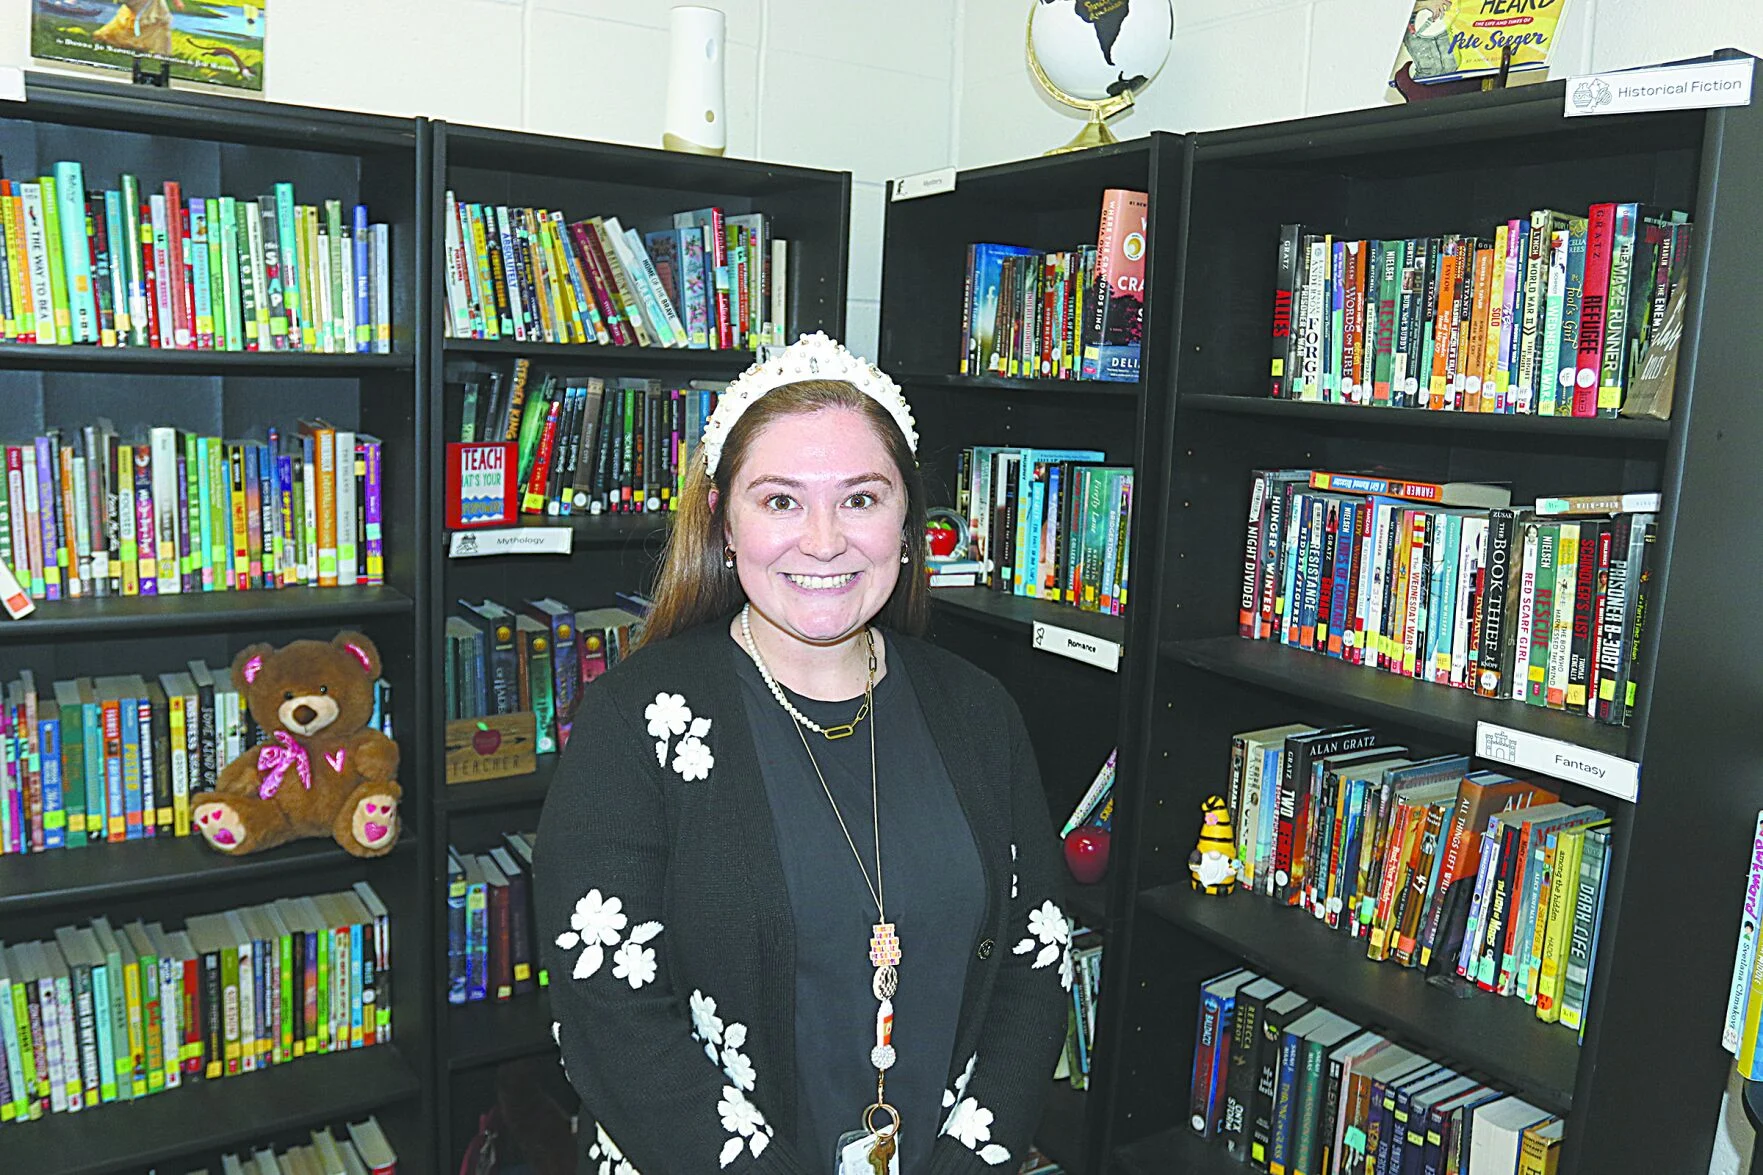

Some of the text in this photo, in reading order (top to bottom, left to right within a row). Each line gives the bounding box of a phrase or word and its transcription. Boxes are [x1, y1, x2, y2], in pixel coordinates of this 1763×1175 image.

[1448, 30, 1548, 56] Pete Seeger
[1618, 80, 1742, 98] Historical Fiction
[1107, 201, 1115, 233] WHERE
[1592, 210, 1604, 260] GRATZ
[31, 232, 40, 250] THE
[1096, 210, 1108, 272] DELIA OWENS
[1282, 240, 1290, 271] GRATZ
[1406, 242, 1414, 266] CURTIS
[1532, 230, 1541, 255] LYNCH
[1661, 239, 1670, 266] SPRADLIN
[34, 255, 44, 275] WAY
[502, 233, 517, 289] ABSOLUTELY
[1385, 251, 1395, 281] NIELSEN
[1443, 263, 1451, 292] TAYLOR
[38, 283, 46, 294] TO
[241, 254, 254, 309] LOSER
[643, 259, 675, 320] HOME OF THE BRAVE
[1097, 256, 1110, 306] CRAWDADS
[1309, 260, 1317, 315] ANDERSON
[1427, 280, 1435, 317] TITANIC
[1462, 279, 1470, 317] TITANIC
[1527, 263, 1538, 314] WORLD WAR
[1094, 309, 1103, 330] SING
[1273, 290, 1292, 337] ALLIES
[1297, 285, 1309, 357] PRISONER WAR
[1451, 300, 1460, 326] CHASING
[1491, 308, 1500, 327] SOLO
[1563, 283, 1582, 349] Fool's Girl
[1579, 295, 1604, 355] REFUGEE
[1605, 243, 1631, 371] THE MAZE RUNNER
[1342, 287, 1356, 376] WORDS FIRE
[1378, 300, 1395, 353] RESCUE
[1399, 327, 1407, 351] BUDDY
[1544, 305, 1558, 370] WEDNESDAY
[1524, 357, 1532, 380] RIGHT
[505, 359, 529, 439] STEPHEN KING
[463, 448, 503, 470] TEACH
[482, 473, 501, 486] YOUR
[1090, 480, 1102, 509] Firefly
[1367, 481, 1379, 492] Girl
[1406, 484, 1435, 498] FARMER
[1107, 510, 1116, 559] BRIDGERTON
[1342, 507, 1351, 533] NIELSEN
[1355, 510, 1363, 536] REEDY
[1263, 495, 1281, 613] HUNGER WINTER
[1297, 527, 1308, 572] HIDDEN
[1325, 535, 1333, 561] GRATZ
[1352, 545, 1360, 574] Words
[1490, 538, 1507, 591] BOOK
[1540, 536, 1552, 568] NIELSEN
[1241, 526, 1258, 609] NIGHT DIVIDED
[1305, 544, 1320, 611] RESISTANCE
[1331, 535, 1348, 631] LINES OF COURAGE
[1318, 577, 1332, 620] GRENADE
[1407, 572, 1419, 623] WEDNESDAY
[1575, 539, 1594, 639] SCHINDLER'S LIST
[1486, 596, 1502, 651] THIEF
[1517, 572, 1532, 663] RED SCARF GIRL
[1532, 589, 1552, 650] RESCUE
[1552, 609, 1562, 647] HARNESSED
[1600, 559, 1626, 673] PRISONER B-3087
[1068, 638, 1096, 653] Romance
[1405, 626, 1414, 651] WARS
[1577, 658, 1586, 680] THOMAS
[1310, 736, 1375, 756] ALAN GRATZ
[125, 743, 138, 791] POSTED
[451, 756, 520, 776] TEACHER
[1286, 751, 1294, 779] GRATZ
[1555, 754, 1606, 779] Fantasy
[1280, 790, 1295, 818] TWO
[1440, 798, 1470, 894] ALL THINGS LEFT WILD
[1555, 850, 1566, 877] among
[1413, 873, 1427, 894] 47
[1477, 844, 1491, 890] ANIMORPHS
[1432, 906, 1442, 926] JAMES
[1486, 880, 1506, 947] THE LION MARS
[1529, 872, 1540, 924] ALICE HOFFMAN
[1550, 894, 1561, 922] hidden
[1570, 883, 1595, 959] DARK LIFE
[1737, 942, 1751, 981] Svetlana
[1202, 1014, 1214, 1046] BALDACCI
[1234, 1005, 1244, 1042] YARROS
[1243, 1006, 1256, 1050] REBECCA
[1224, 1097, 1235, 1131] STORM
[1233, 1104, 1244, 1133] ONYX
